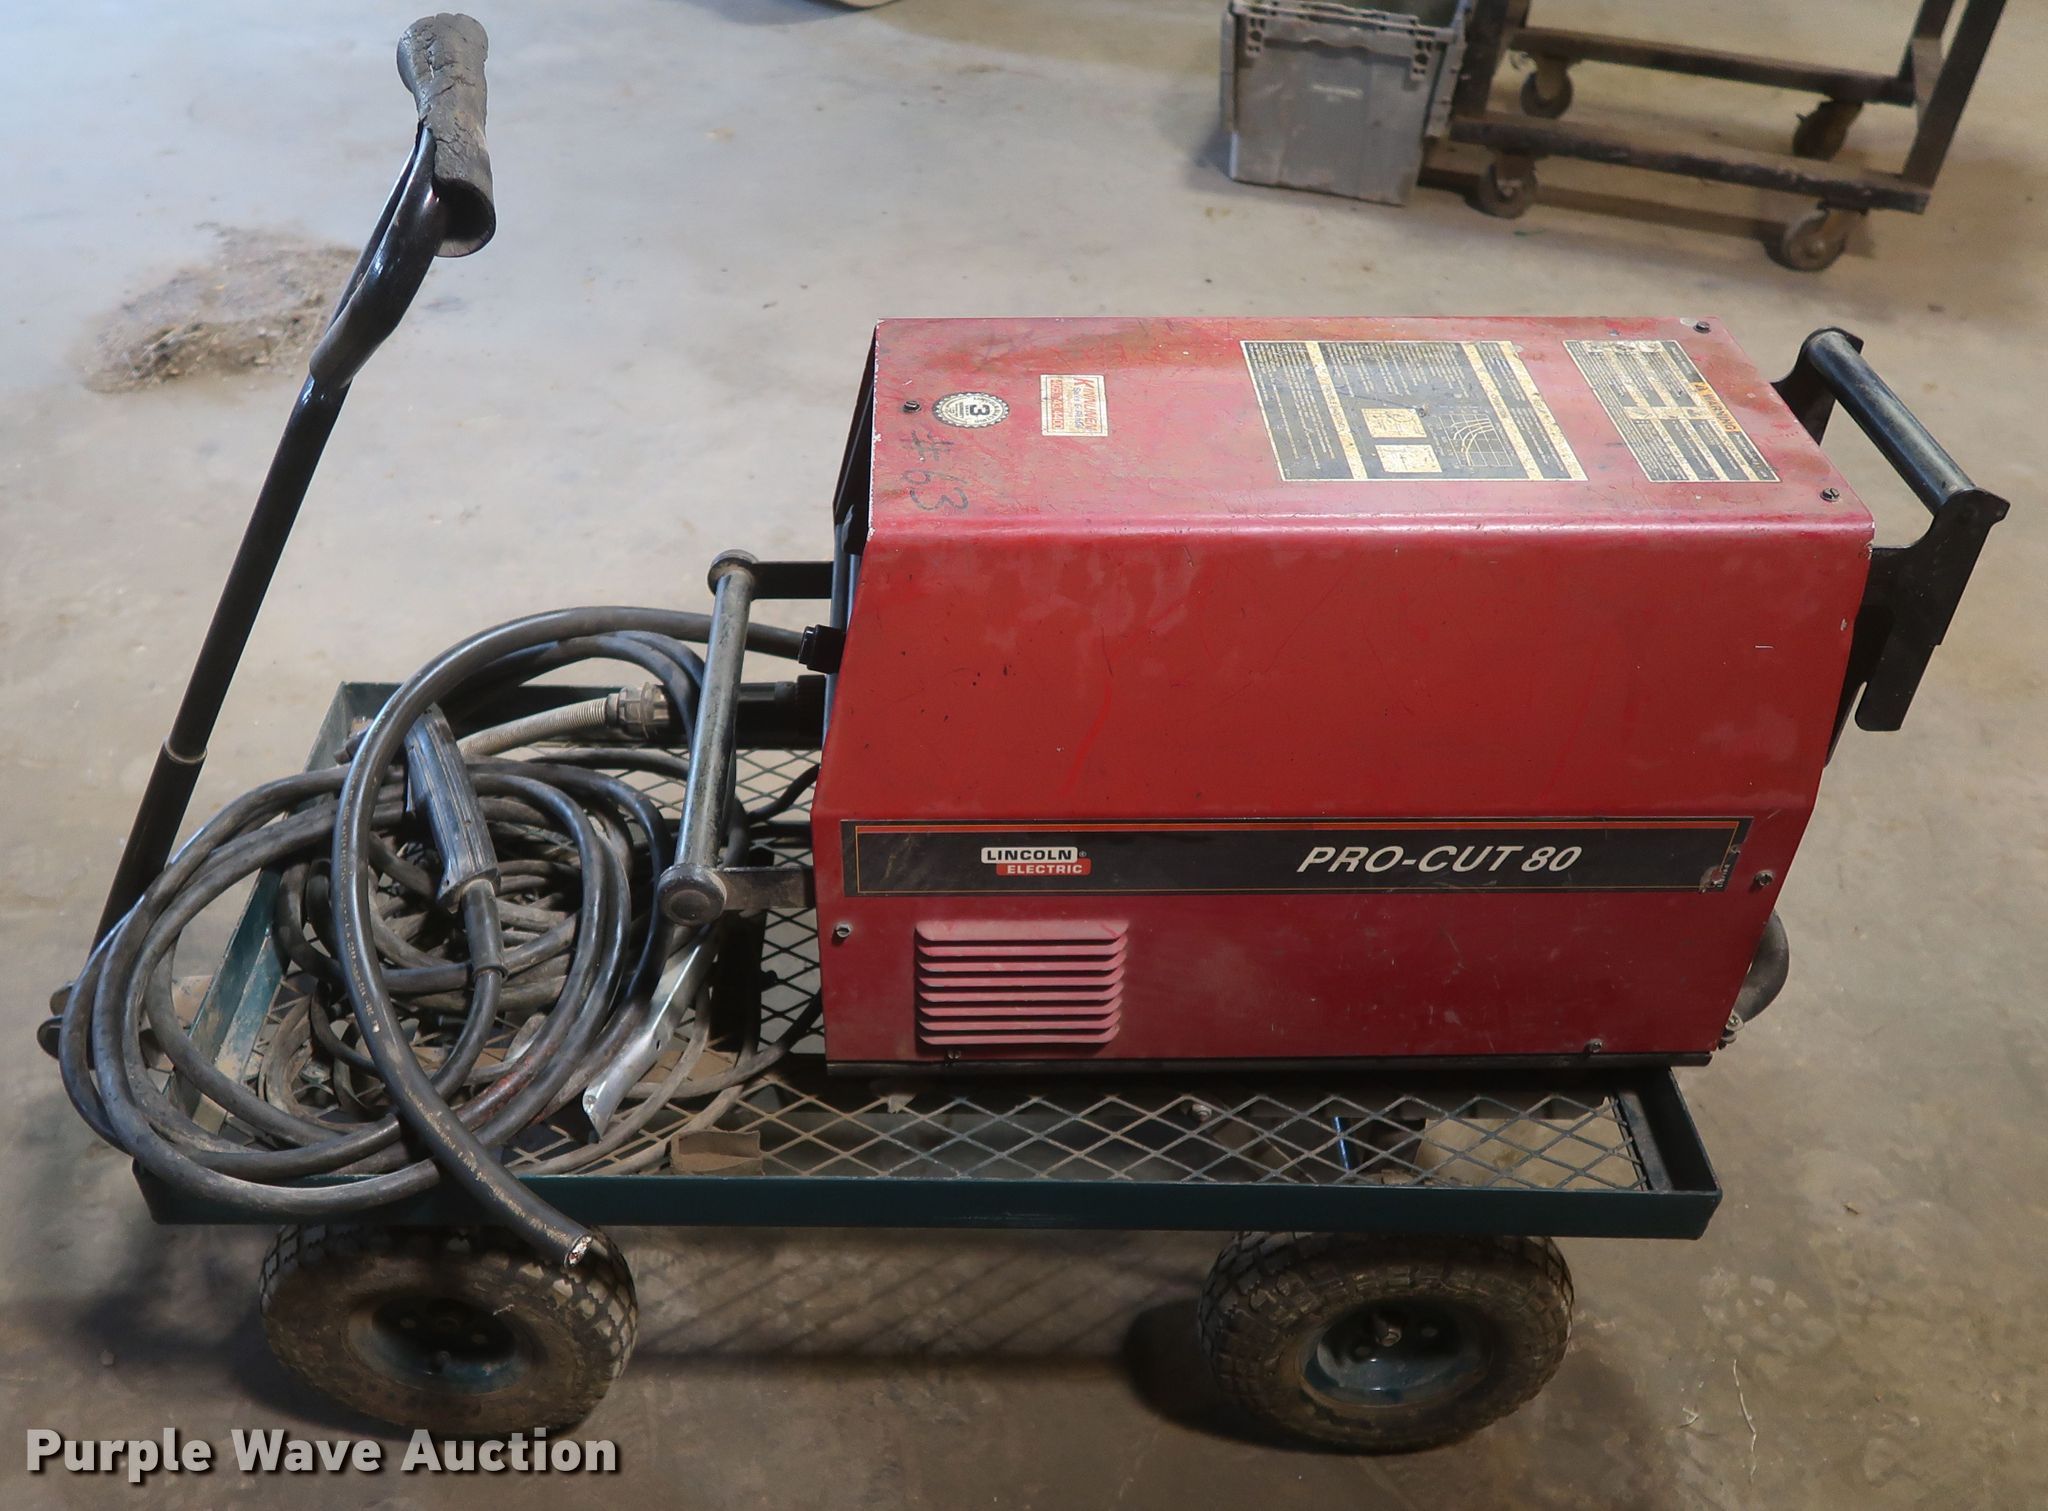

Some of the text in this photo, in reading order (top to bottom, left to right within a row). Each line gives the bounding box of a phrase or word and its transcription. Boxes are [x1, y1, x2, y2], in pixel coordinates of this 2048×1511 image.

[969, 404, 991, 416] 3
[1702, 393, 1737, 431] WARNING
[986, 849, 1072, 861] LINCOLN
[1296, 845, 1583, 873] PRO-CUT 80
[1006, 864, 1083, 875] ELECTRIC
